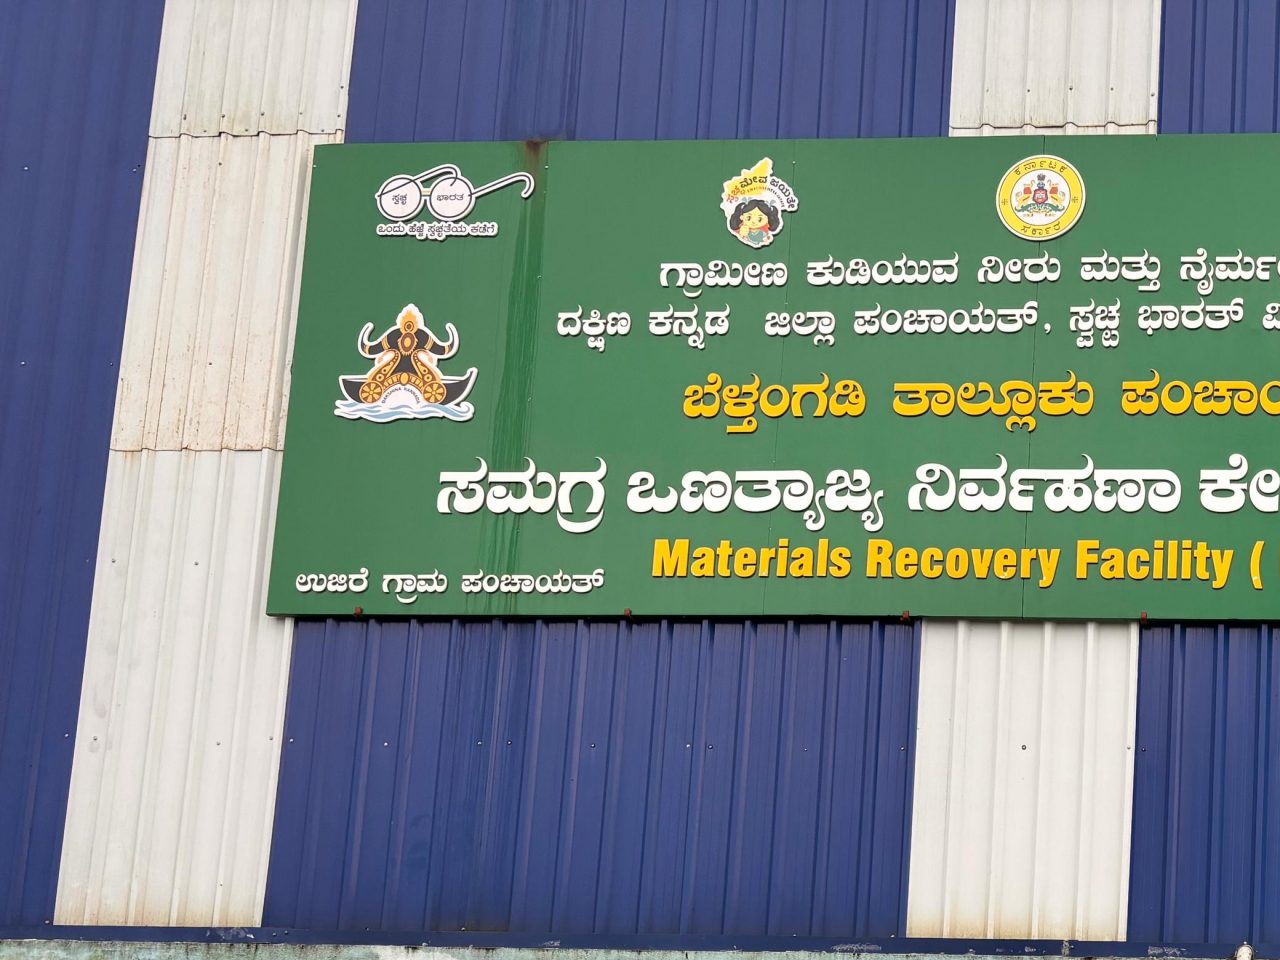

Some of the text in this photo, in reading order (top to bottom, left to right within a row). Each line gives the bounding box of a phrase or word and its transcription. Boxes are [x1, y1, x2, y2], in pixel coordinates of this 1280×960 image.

[660, 260, 787, 297] ಗ್ರಾಮೀಣ
[807, 252, 958, 285] ಕುಡಿಯುವ
[978, 251, 1060, 282] ನೀರು
[1081, 249, 1160, 290] ಮತ್ತು
[557, 305, 630, 351] ದಕ್ಷಿಣ
[649, 304, 730, 349] ಕನ್ನಡ
[765, 311, 835, 345] ಜಿಲ್ಲಾ
[1138, 298, 1243, 334] ಭಾರತ್
[684, 373, 865, 432] ಬೆಳ್ತಂಗಡಿ
[893, 374, 1093, 430] ತಾಲ್ಲೂಕು
[437, 457, 606, 532] ಸಮಗ್ರ
[627, 469, 883, 531] ಒಣತ್ಯಾಜ್ಯ
[908, 454, 1181, 512] ನಿರ್ವಹಣಾ
[296, 568, 604, 603] ಉಜಿರೆ ಗ್ರಾಮ ಪಂಚಾಯತ್
[652, 539, 850, 576] Materials
[867, 539, 1060, 587] Recovery
[1077, 540, 1233, 588] Facility
